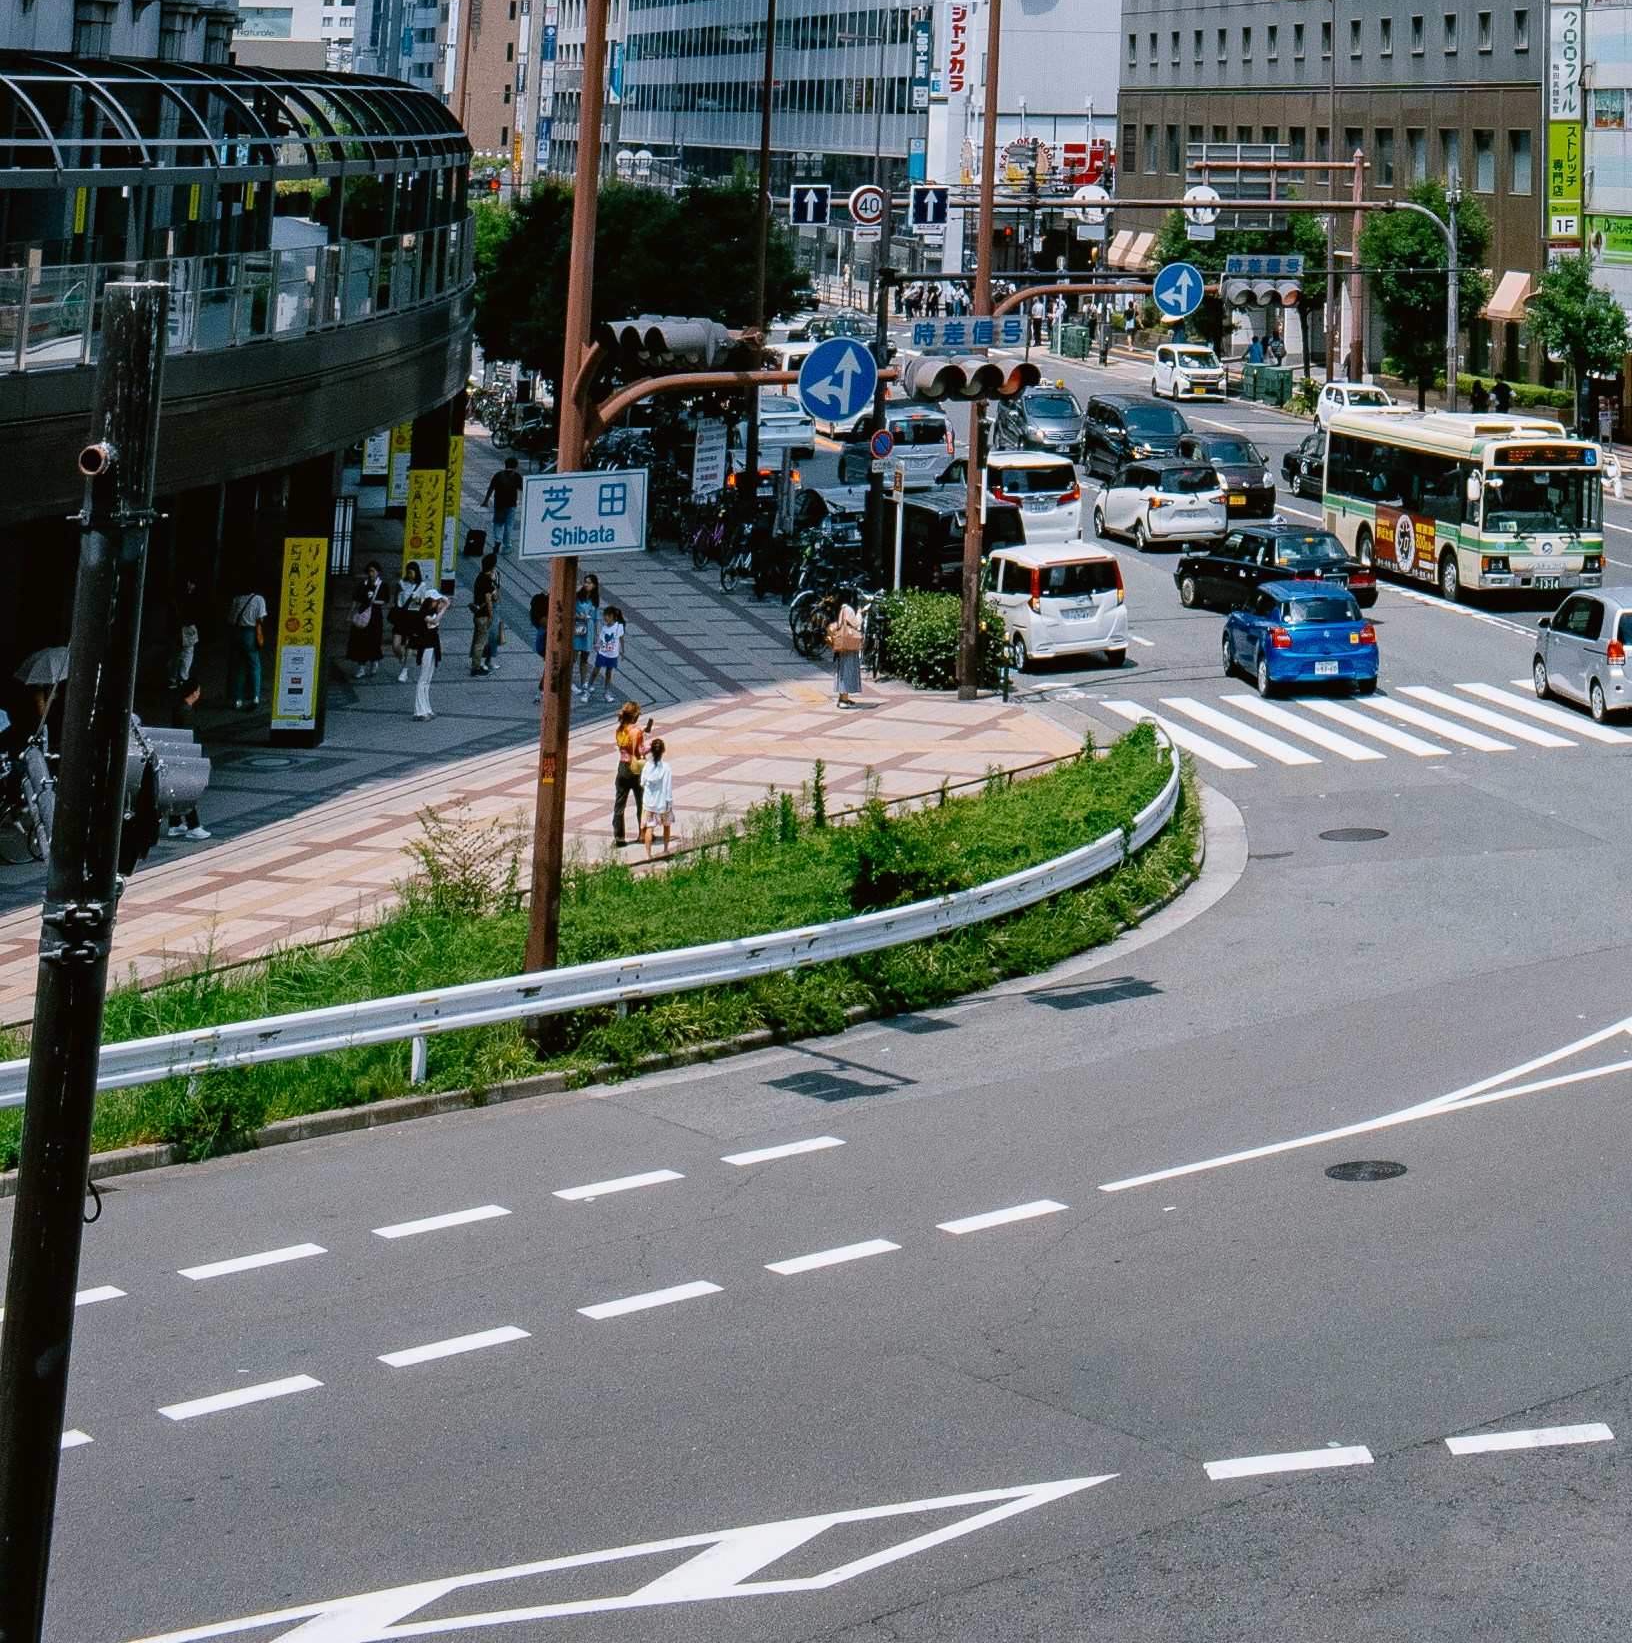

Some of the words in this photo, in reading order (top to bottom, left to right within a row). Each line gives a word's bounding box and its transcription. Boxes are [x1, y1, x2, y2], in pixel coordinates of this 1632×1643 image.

[947, 5, 968, 93] ジャンカラ
[1566, 126, 1577, 188] ストレッチ
[1552, 158, 1564, 197] 専門店
[858, 197, 880, 214] 40
[1556, 219, 1574, 233] 1F
[1227, 258, 1303, 274] 時差信号
[913, 319, 1024, 348] 時差信号
[540, 482, 627, 523] 芝田
[550, 524, 615, 547] Shibata
[302, 543, 320, 634] リンクスる
